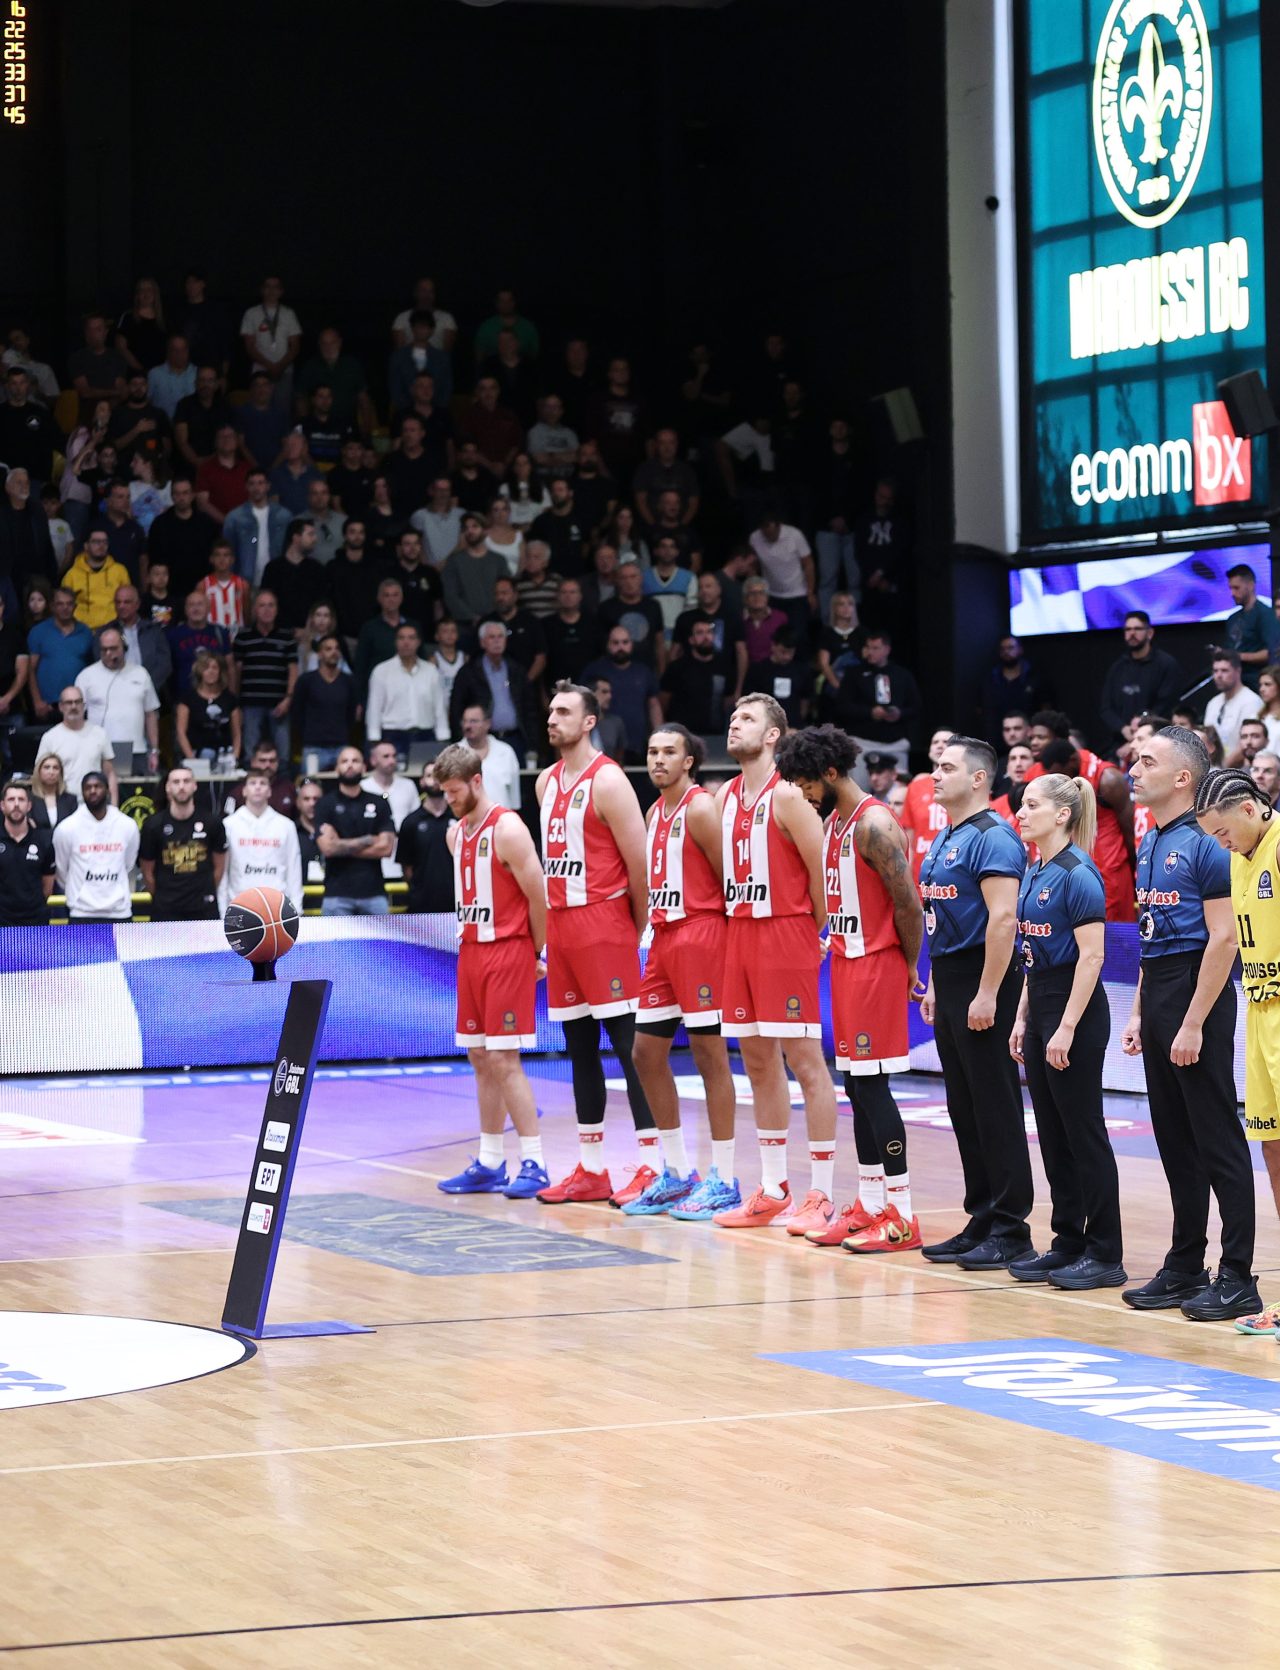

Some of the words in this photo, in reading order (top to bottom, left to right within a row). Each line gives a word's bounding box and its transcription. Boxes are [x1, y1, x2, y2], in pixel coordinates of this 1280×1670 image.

[10, 0, 26, 17] 16
[3, 20, 26, 39] 22
[3, 41, 26, 60] 25
[4, 62, 26, 82] 33
[4, 84, 26, 103] 37
[3, 105, 26, 125] 45
[1068, 243, 1206, 360] MAROUSSI
[1208, 236, 1251, 334] BC
[928, 802, 948, 831] 16
[548, 817, 566, 844] 33
[653, 848, 663, 875] 3
[736, 838, 750, 866] 14
[85, 869, 119, 881] bwin
[244, 861, 277, 875] bwin
[543, 852, 583, 877] win
[827, 867, 840, 896] 22
[649, 882, 681, 908] win
[827, 906, 859, 934] win
[1237, 914, 1256, 948] 11
[285, 1074, 300, 1095] GBL
[1246, 1116, 1277, 1130] ovibet
